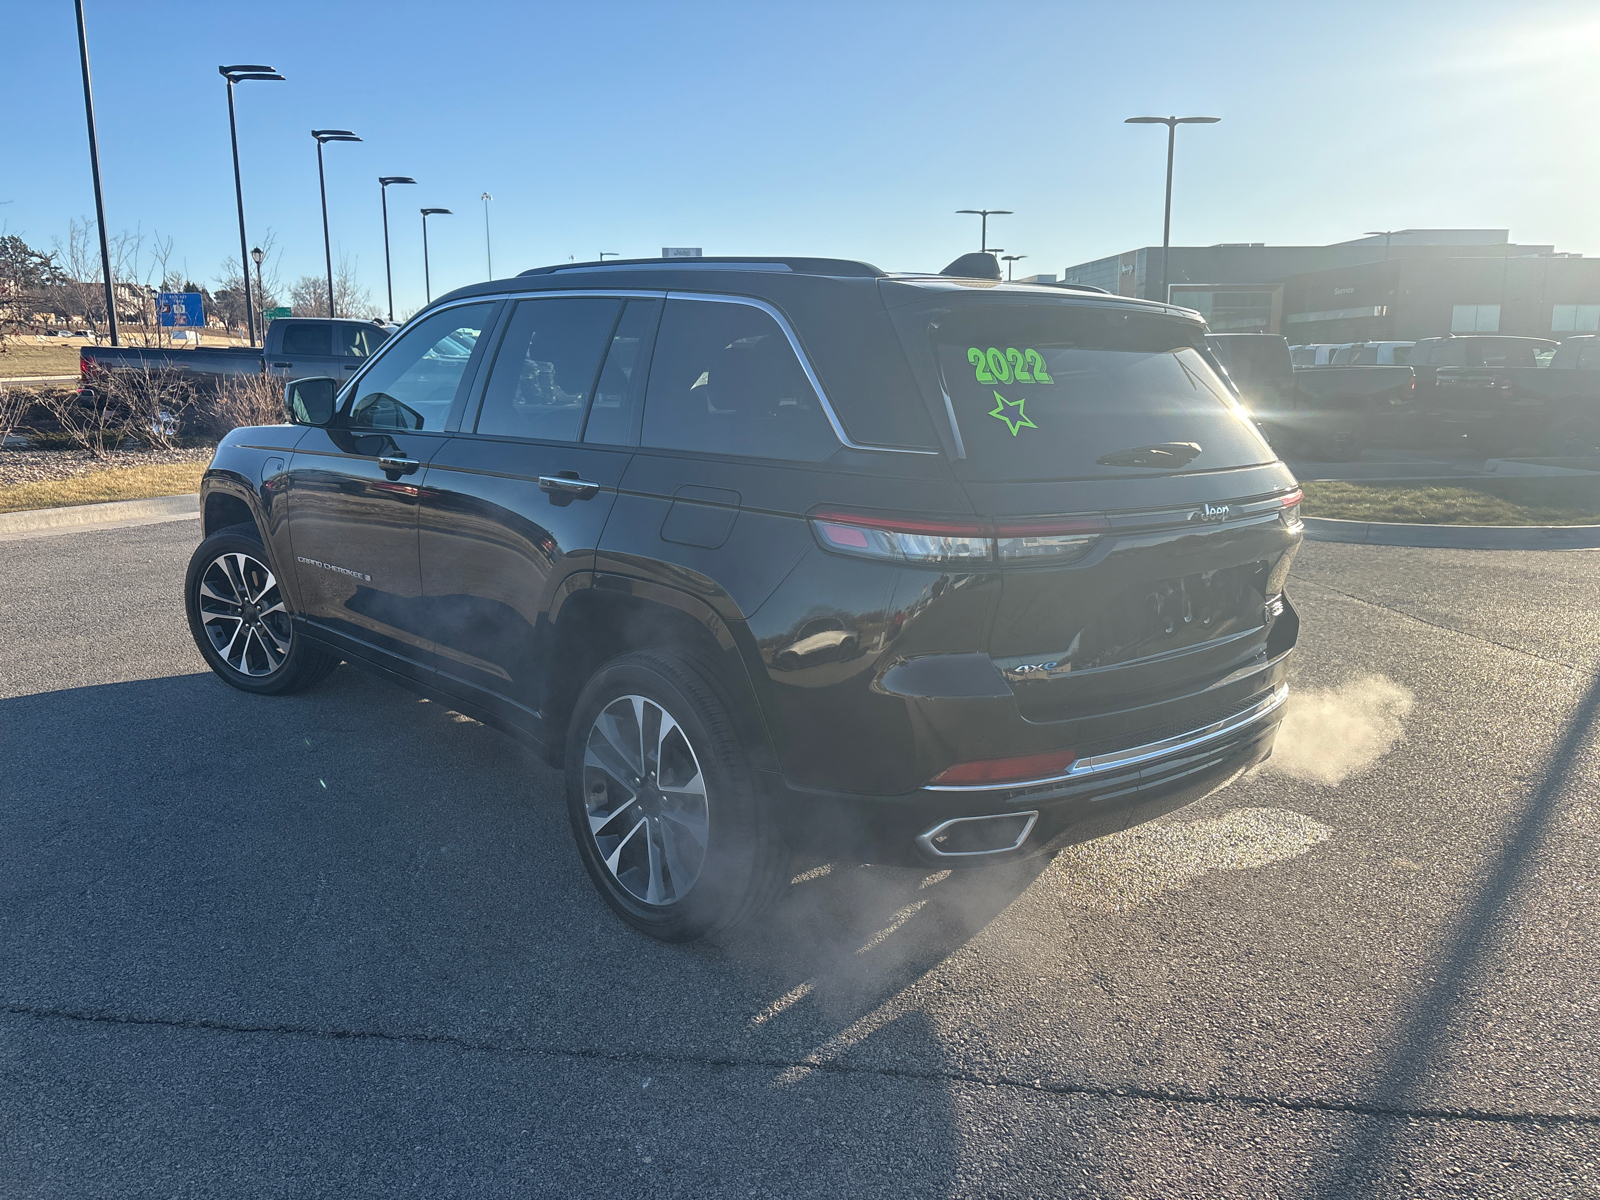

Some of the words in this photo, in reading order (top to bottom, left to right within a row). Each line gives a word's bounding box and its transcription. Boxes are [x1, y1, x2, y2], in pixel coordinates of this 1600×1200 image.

[967, 347, 1055, 385] 2022
[1201, 503, 1230, 522] Jeep
[297, 556, 322, 567] GRAND
[323, 563, 364, 580] CHEROKEE
